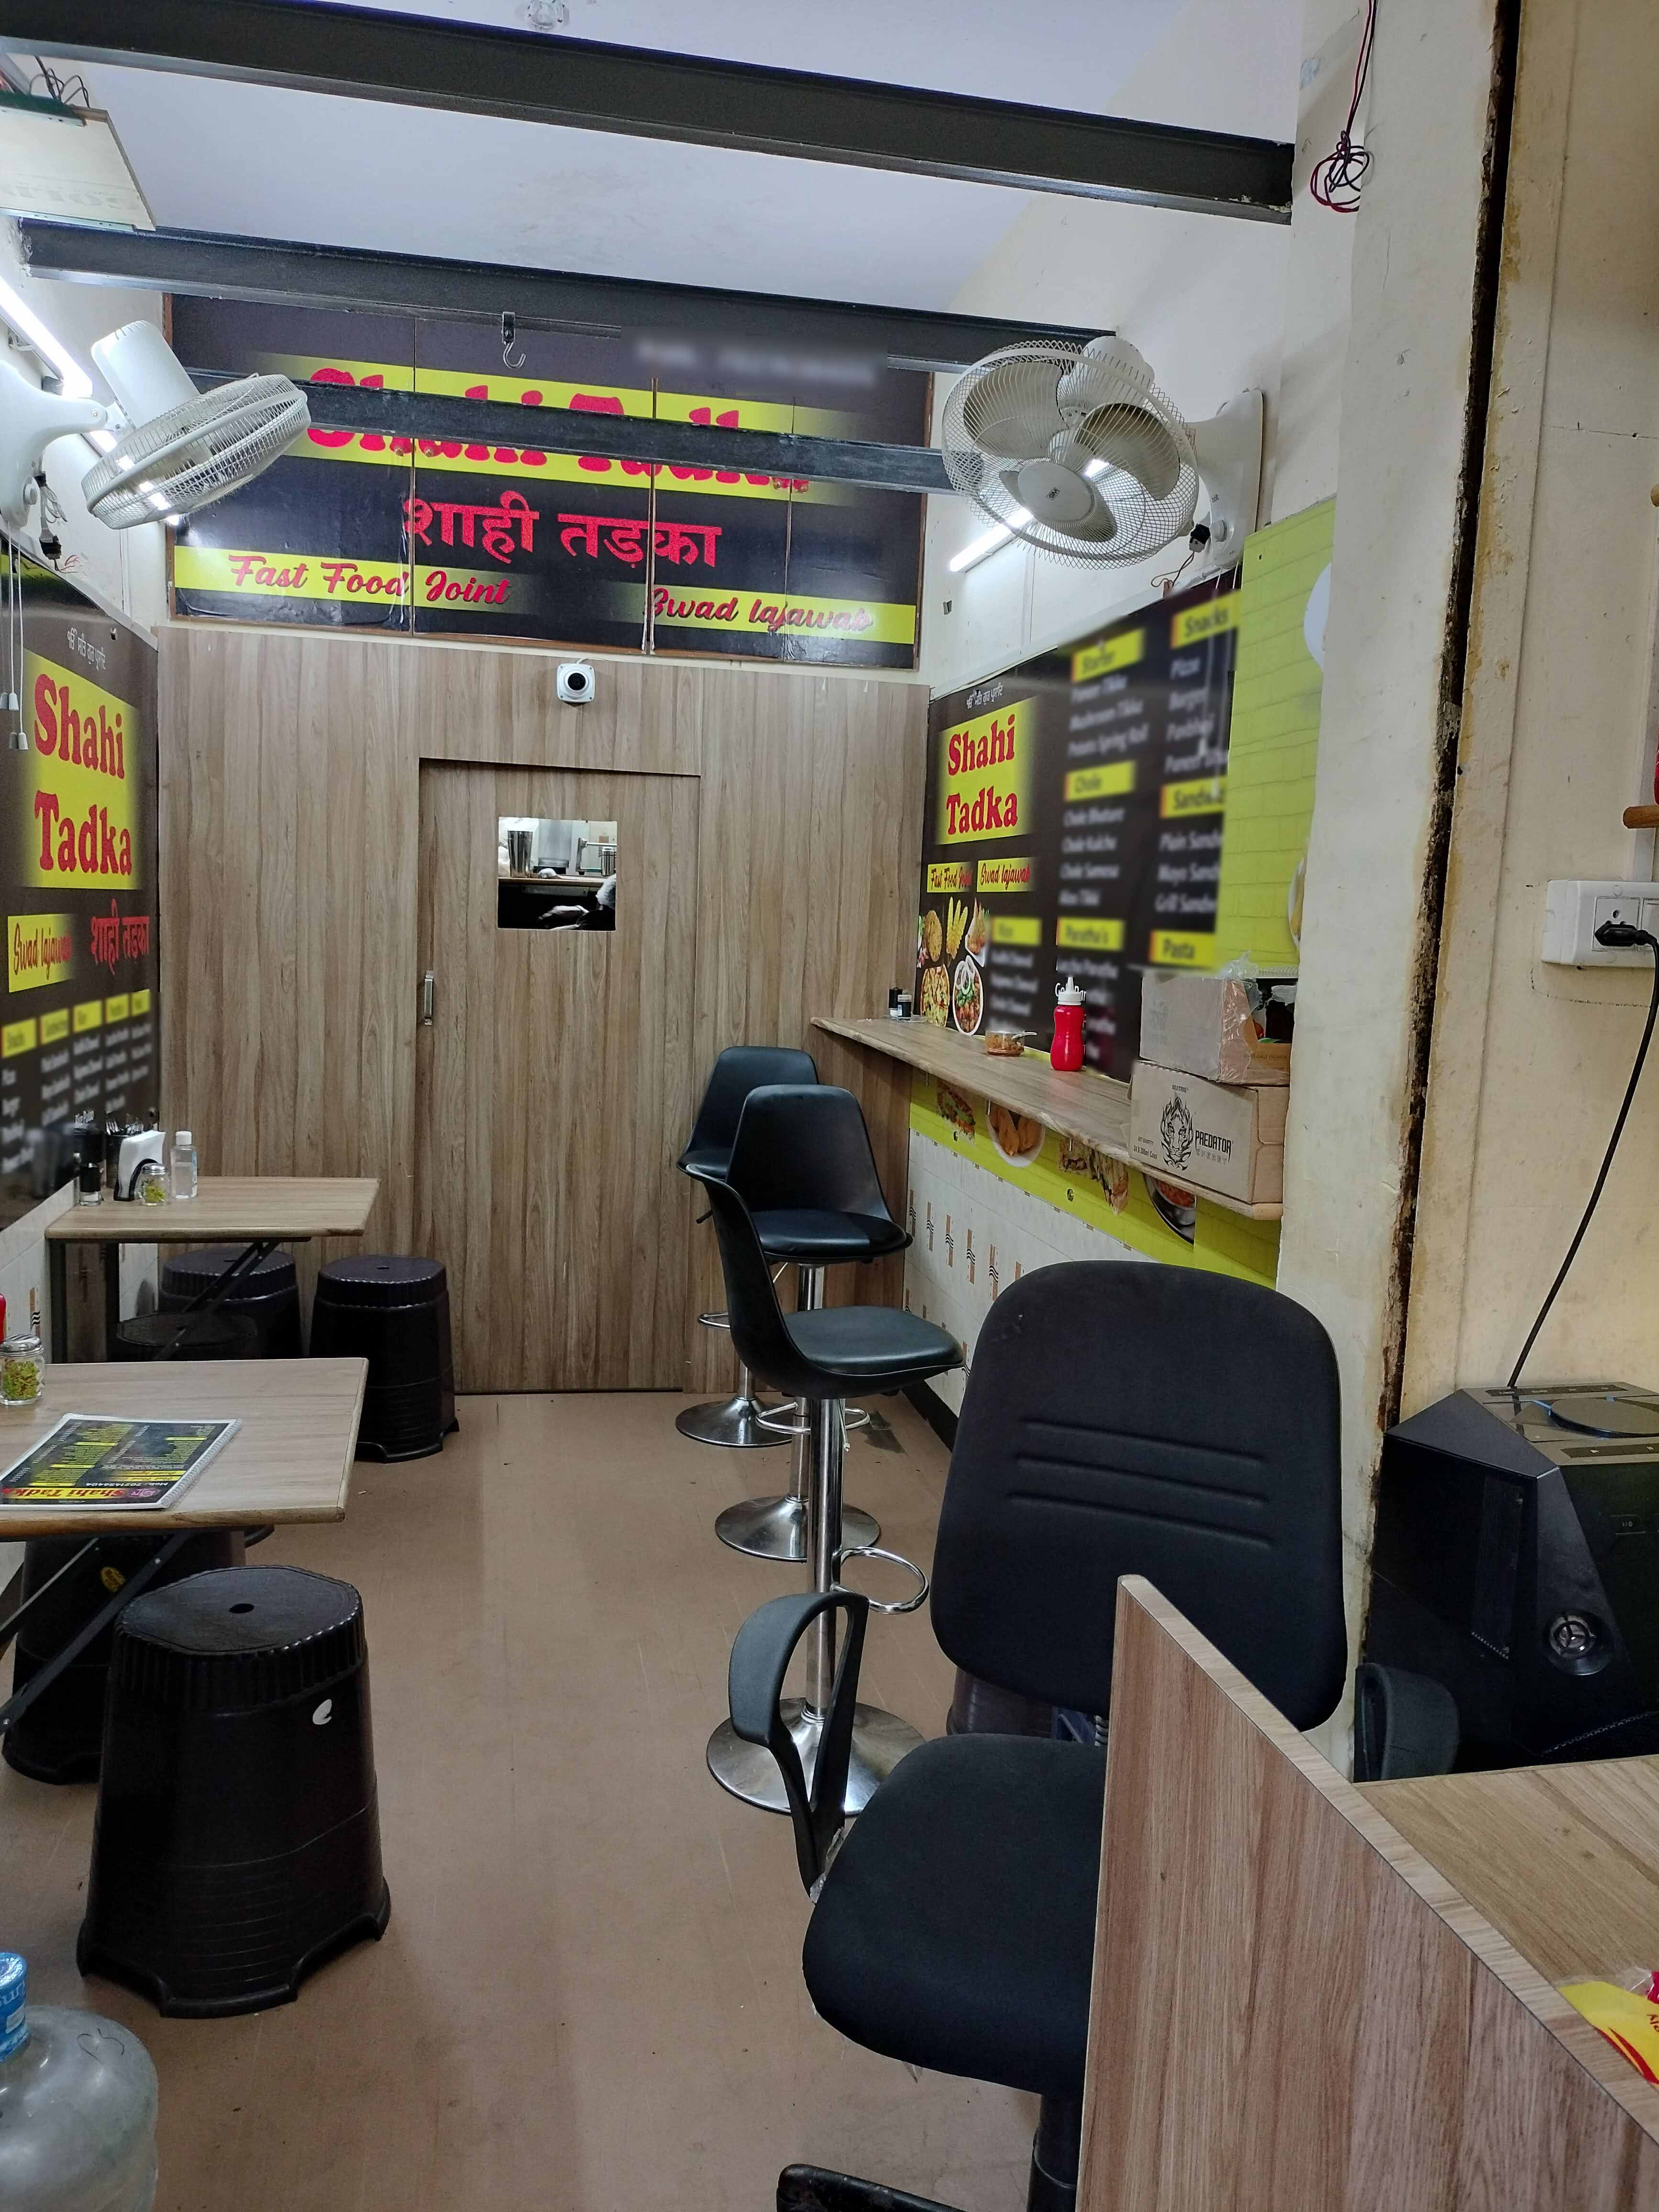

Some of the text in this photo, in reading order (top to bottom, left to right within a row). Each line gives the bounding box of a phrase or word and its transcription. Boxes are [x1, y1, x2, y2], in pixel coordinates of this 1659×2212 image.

[403, 489, 722, 568] शाही तड़का
[229, 554, 512, 604] Fast Food Joint
[749, 598, 873, 632] lajawab
[34, 674, 125, 779] Shahi
[948, 714, 1016, 776] Shahi
[34, 790, 132, 875] Tadka
[946, 785, 1018, 835] Tadka
[931, 868, 942, 890] Fast
[981, 863, 1000, 885] Swad
[1001, 863, 1030, 890] lajawab
[14, 923, 38, 975] Swad
[1195, 1129, 1232, 1162] PREDATOR
[66, 1489, 126, 1497] Shahi
